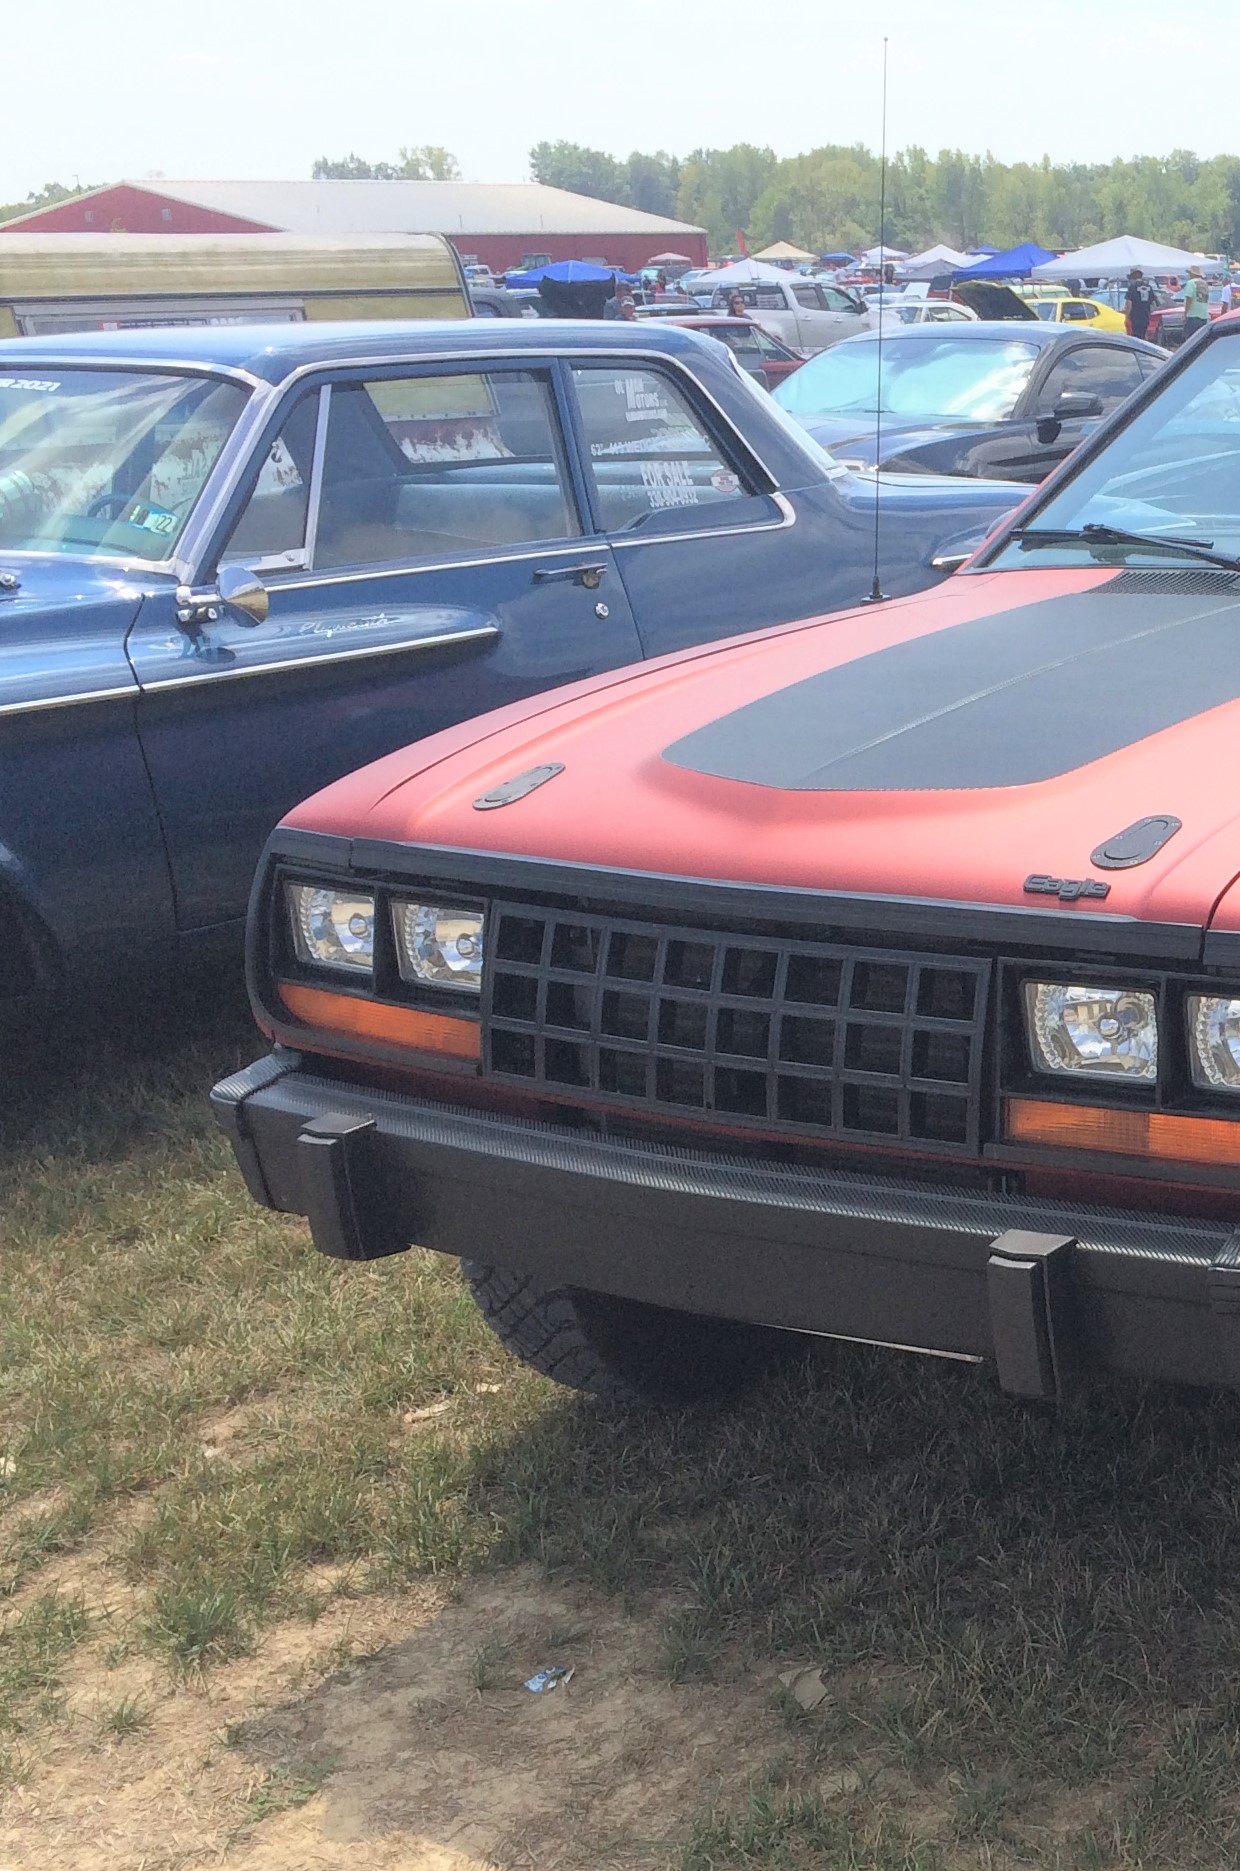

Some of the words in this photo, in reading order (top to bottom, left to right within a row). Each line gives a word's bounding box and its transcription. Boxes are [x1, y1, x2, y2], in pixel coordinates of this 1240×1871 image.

[10, 379, 61, 391] 2021
[640, 462, 664, 487] FOR
[663, 460, 694, 486] SALE
[155, 514, 173, 533] 22
[300, 612, 400, 638] Plymouth
[1023, 873, 1112, 901] Eagle
